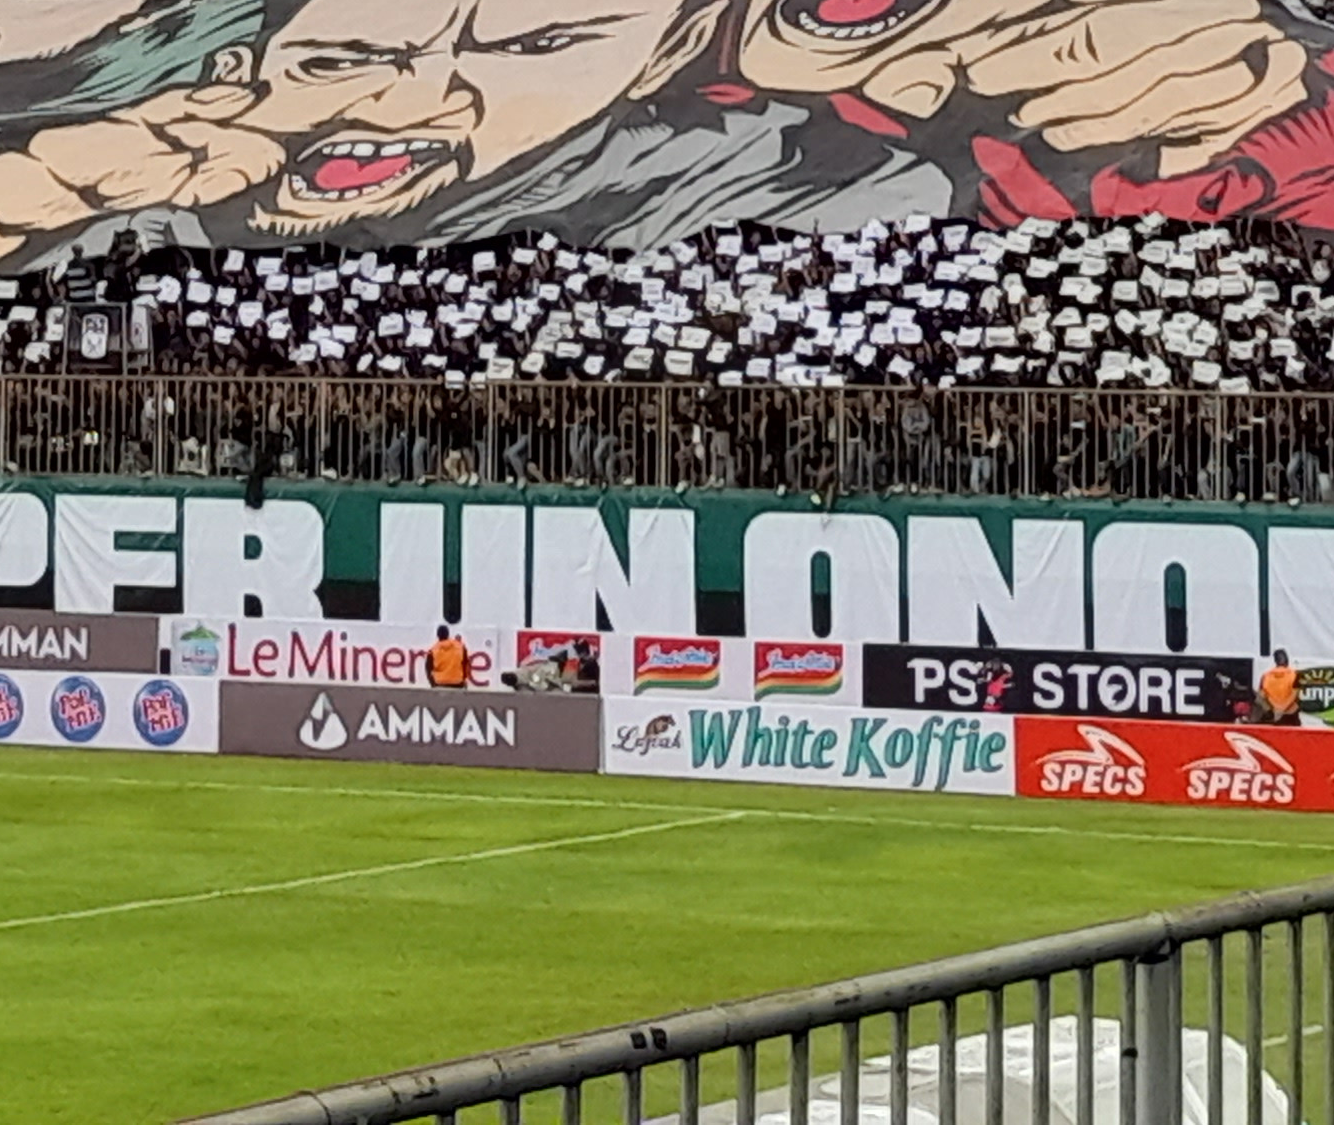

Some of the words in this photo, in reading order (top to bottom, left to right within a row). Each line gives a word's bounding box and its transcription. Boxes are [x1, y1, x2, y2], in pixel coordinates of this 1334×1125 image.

[379, 502, 696, 636] UN
[227, 622, 279, 677] Le
[289, 628, 492, 687] Minere
[906, 657, 987, 706] PS
[1032, 661, 1205, 716] STORE
[357, 703, 515, 747] AMMAN
[687, 705, 839, 769] White
[841, 714, 1008, 792] Koffie
[1040, 762, 1147, 796] SPECS
[1187, 769, 1295, 804] SPECS
